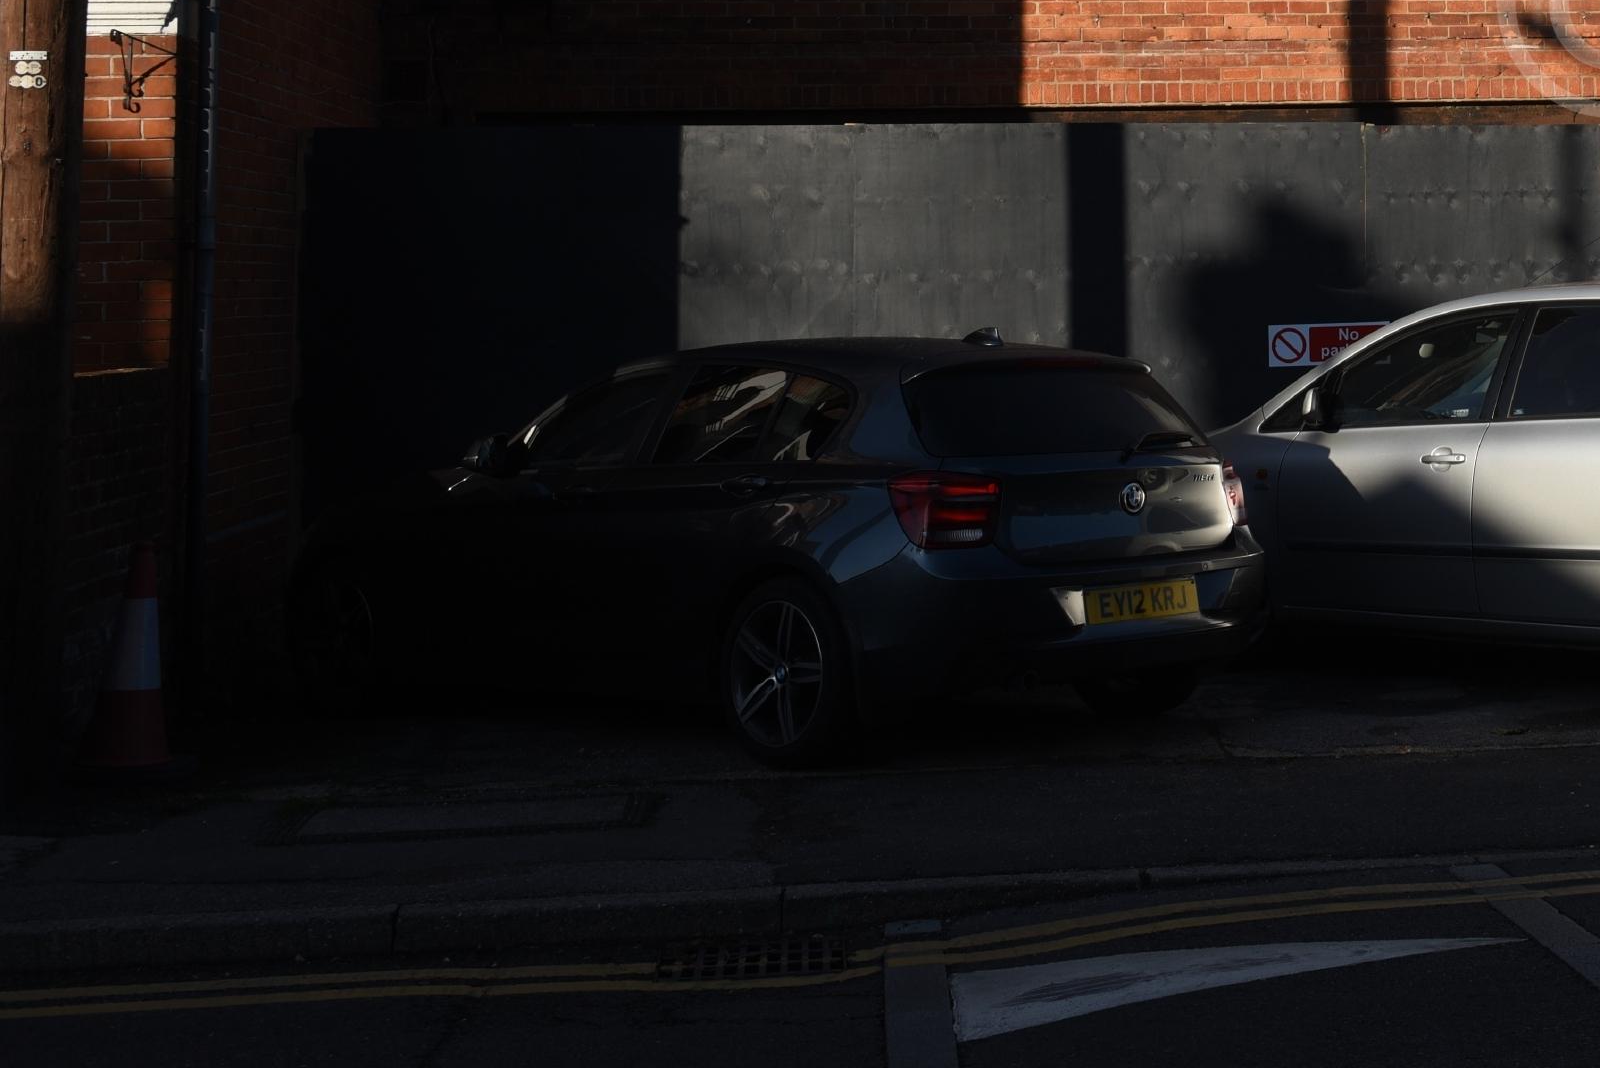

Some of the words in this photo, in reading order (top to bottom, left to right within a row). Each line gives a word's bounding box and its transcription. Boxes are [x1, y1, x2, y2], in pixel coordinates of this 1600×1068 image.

[1338, 328, 1360, 341] No
[1101, 589, 1147, 618] EY12
[1150, 585, 1188, 612] KRJ
